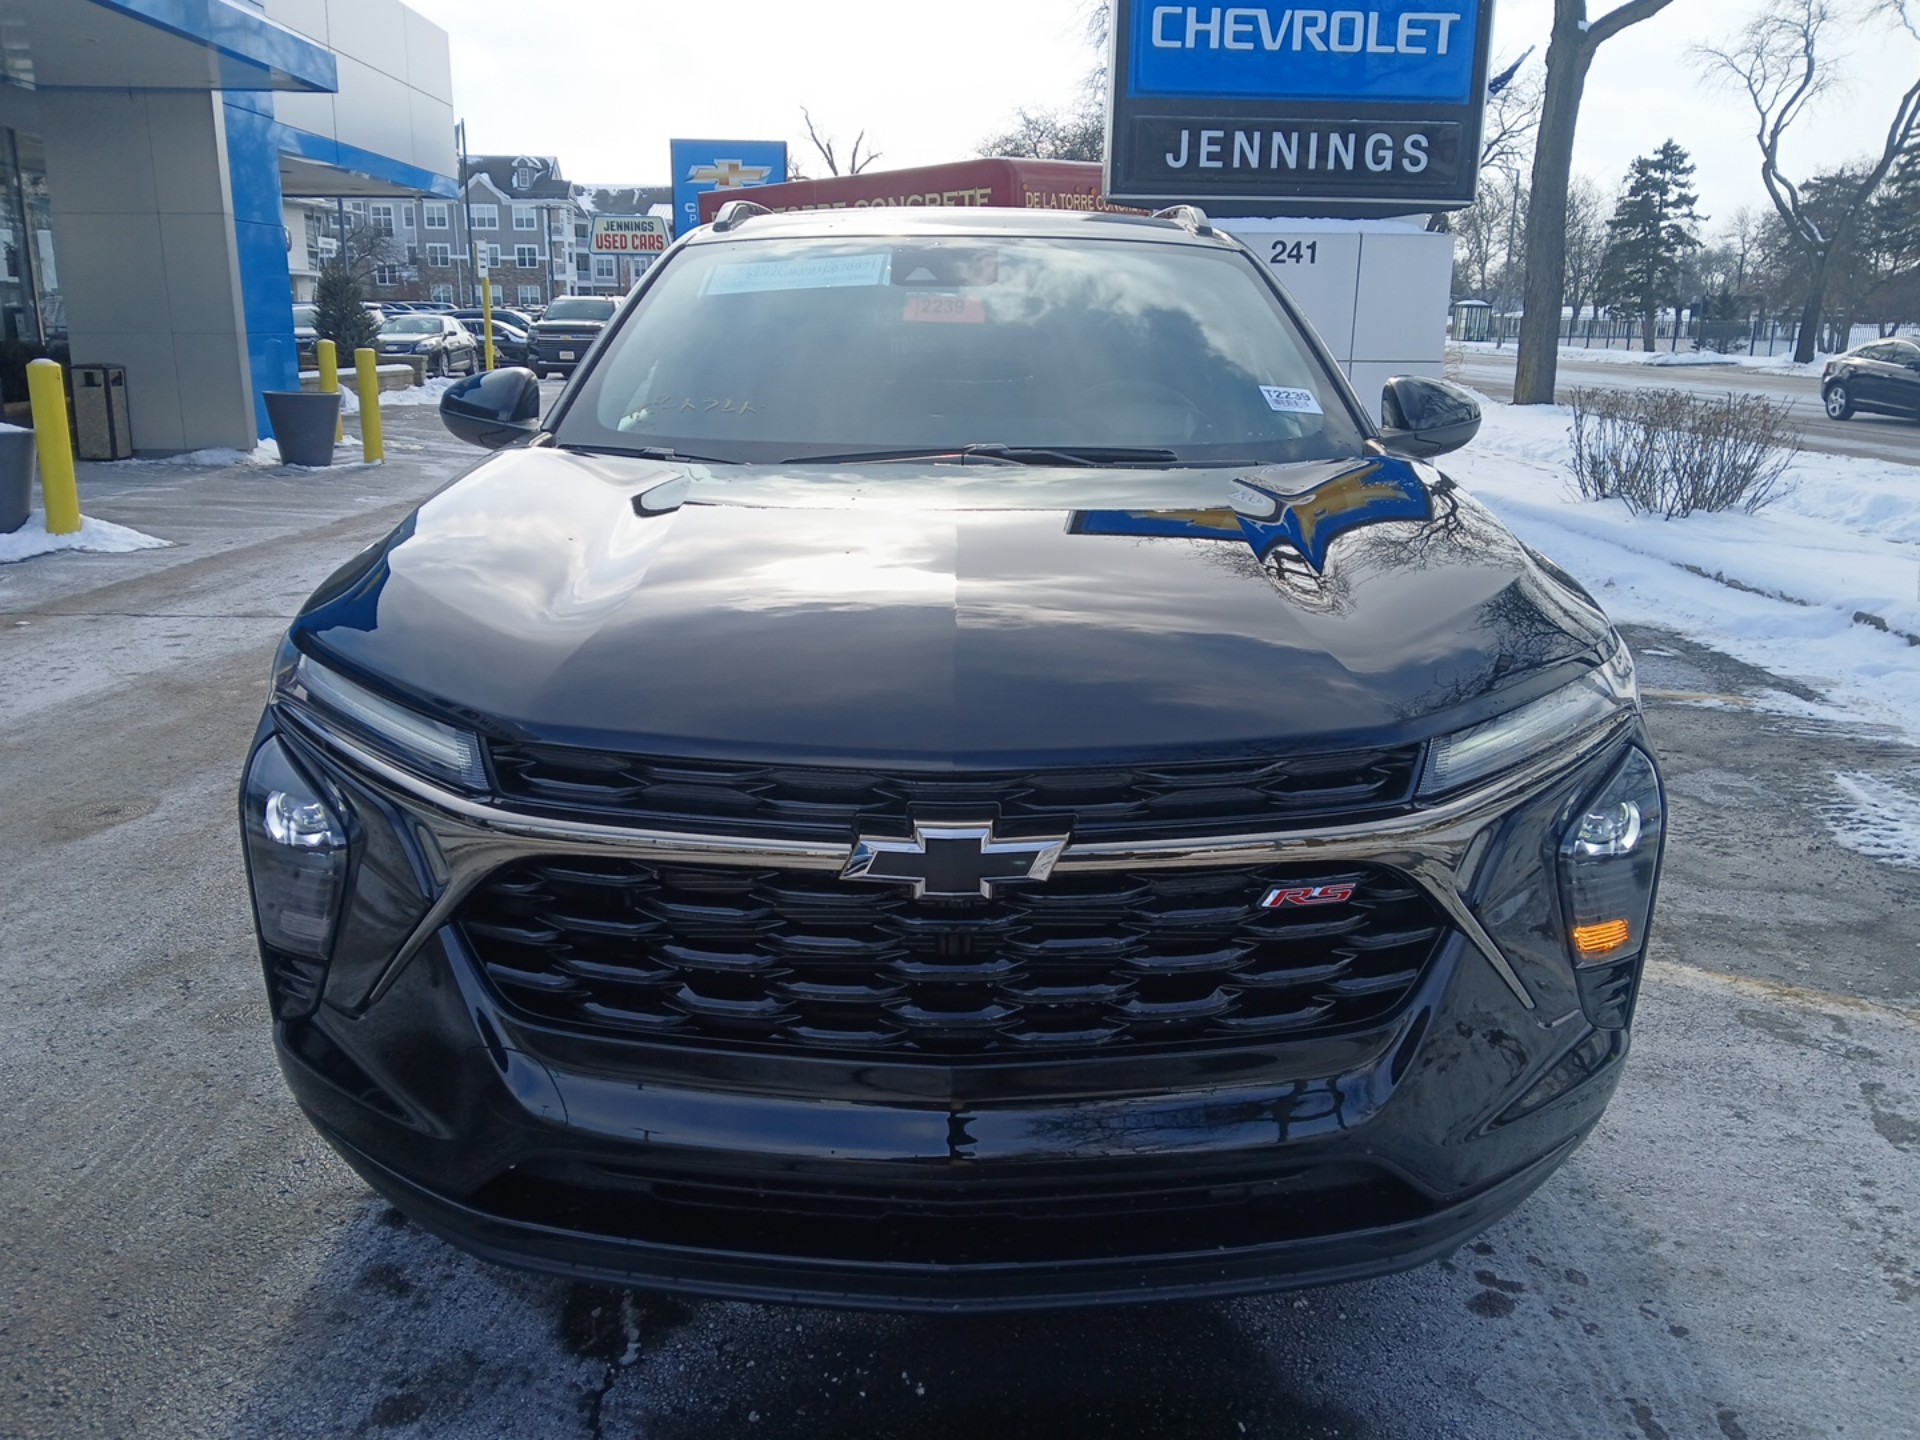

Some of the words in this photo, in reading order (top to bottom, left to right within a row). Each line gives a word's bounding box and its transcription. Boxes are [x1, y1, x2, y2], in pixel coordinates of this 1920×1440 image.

[1152, 6, 1461, 55] CHEVROLET
[1165, 129, 1430, 173] JENNINGS
[1026, 192, 1041, 208] DE
[1043, 193, 1057, 208] LA
[1059, 194, 1094, 210] TORRE
[603, 220, 654, 232] JENNINGS
[595, 233, 628, 250] USED
[631, 234, 664, 250] CARS
[1270, 240, 1317, 264] 241
[1263, 389, 1311, 401] T2239
[1261, 882, 1357, 908] RS
